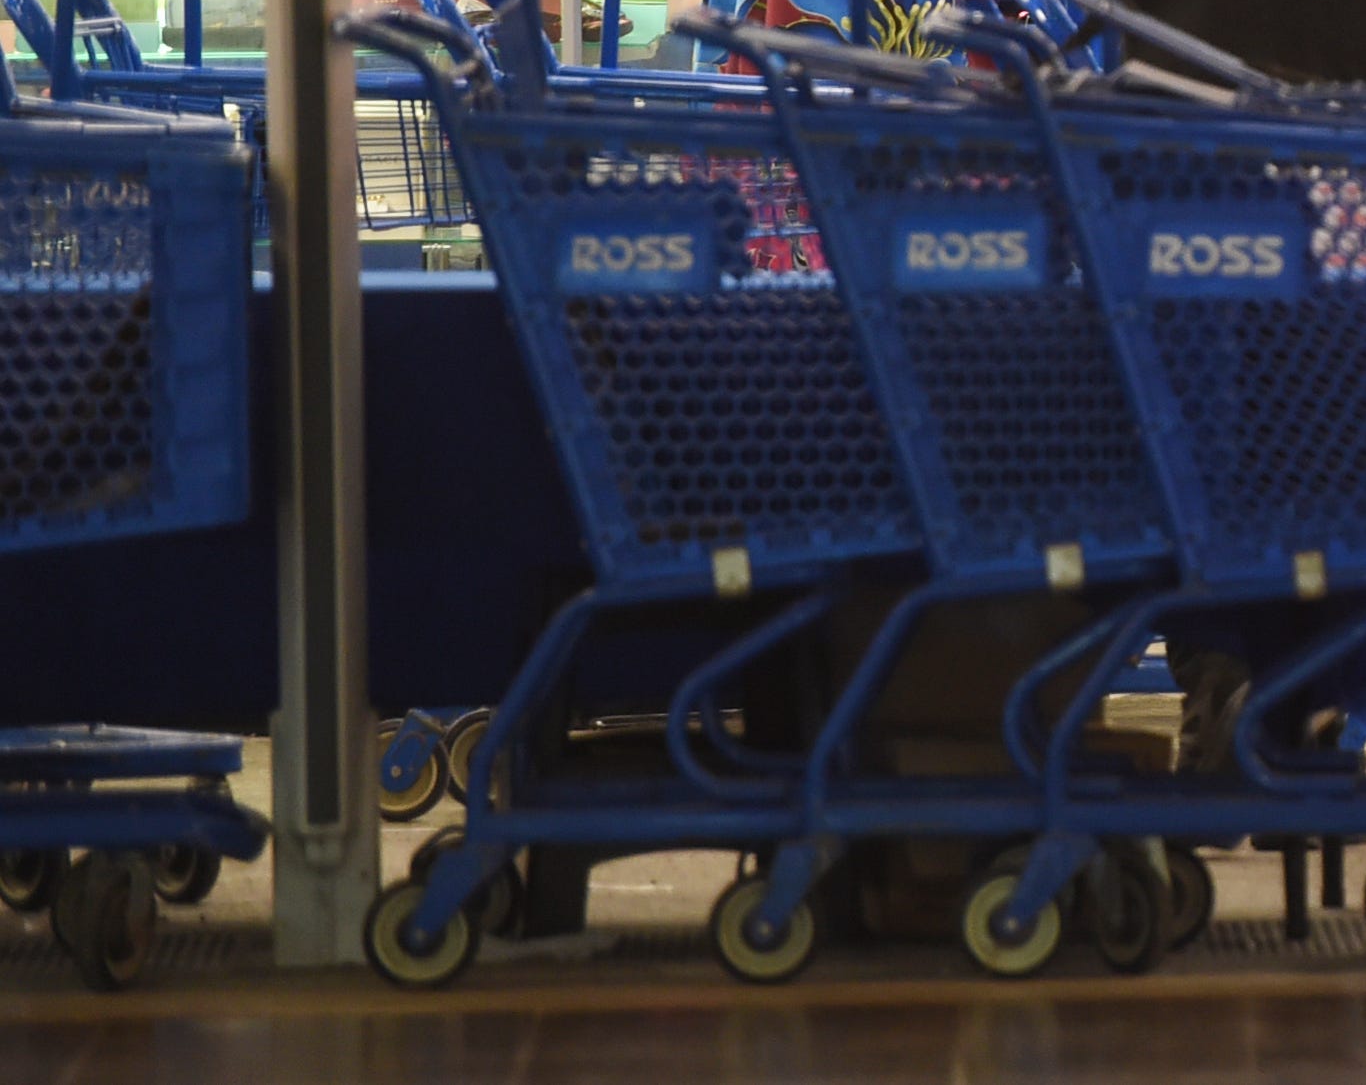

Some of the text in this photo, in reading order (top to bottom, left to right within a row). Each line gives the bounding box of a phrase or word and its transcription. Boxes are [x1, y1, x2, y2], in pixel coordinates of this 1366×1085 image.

[573, 234, 695, 272] ROSS
[907, 230, 1030, 270] ROSS
[1151, 233, 1286, 277] ROSS
